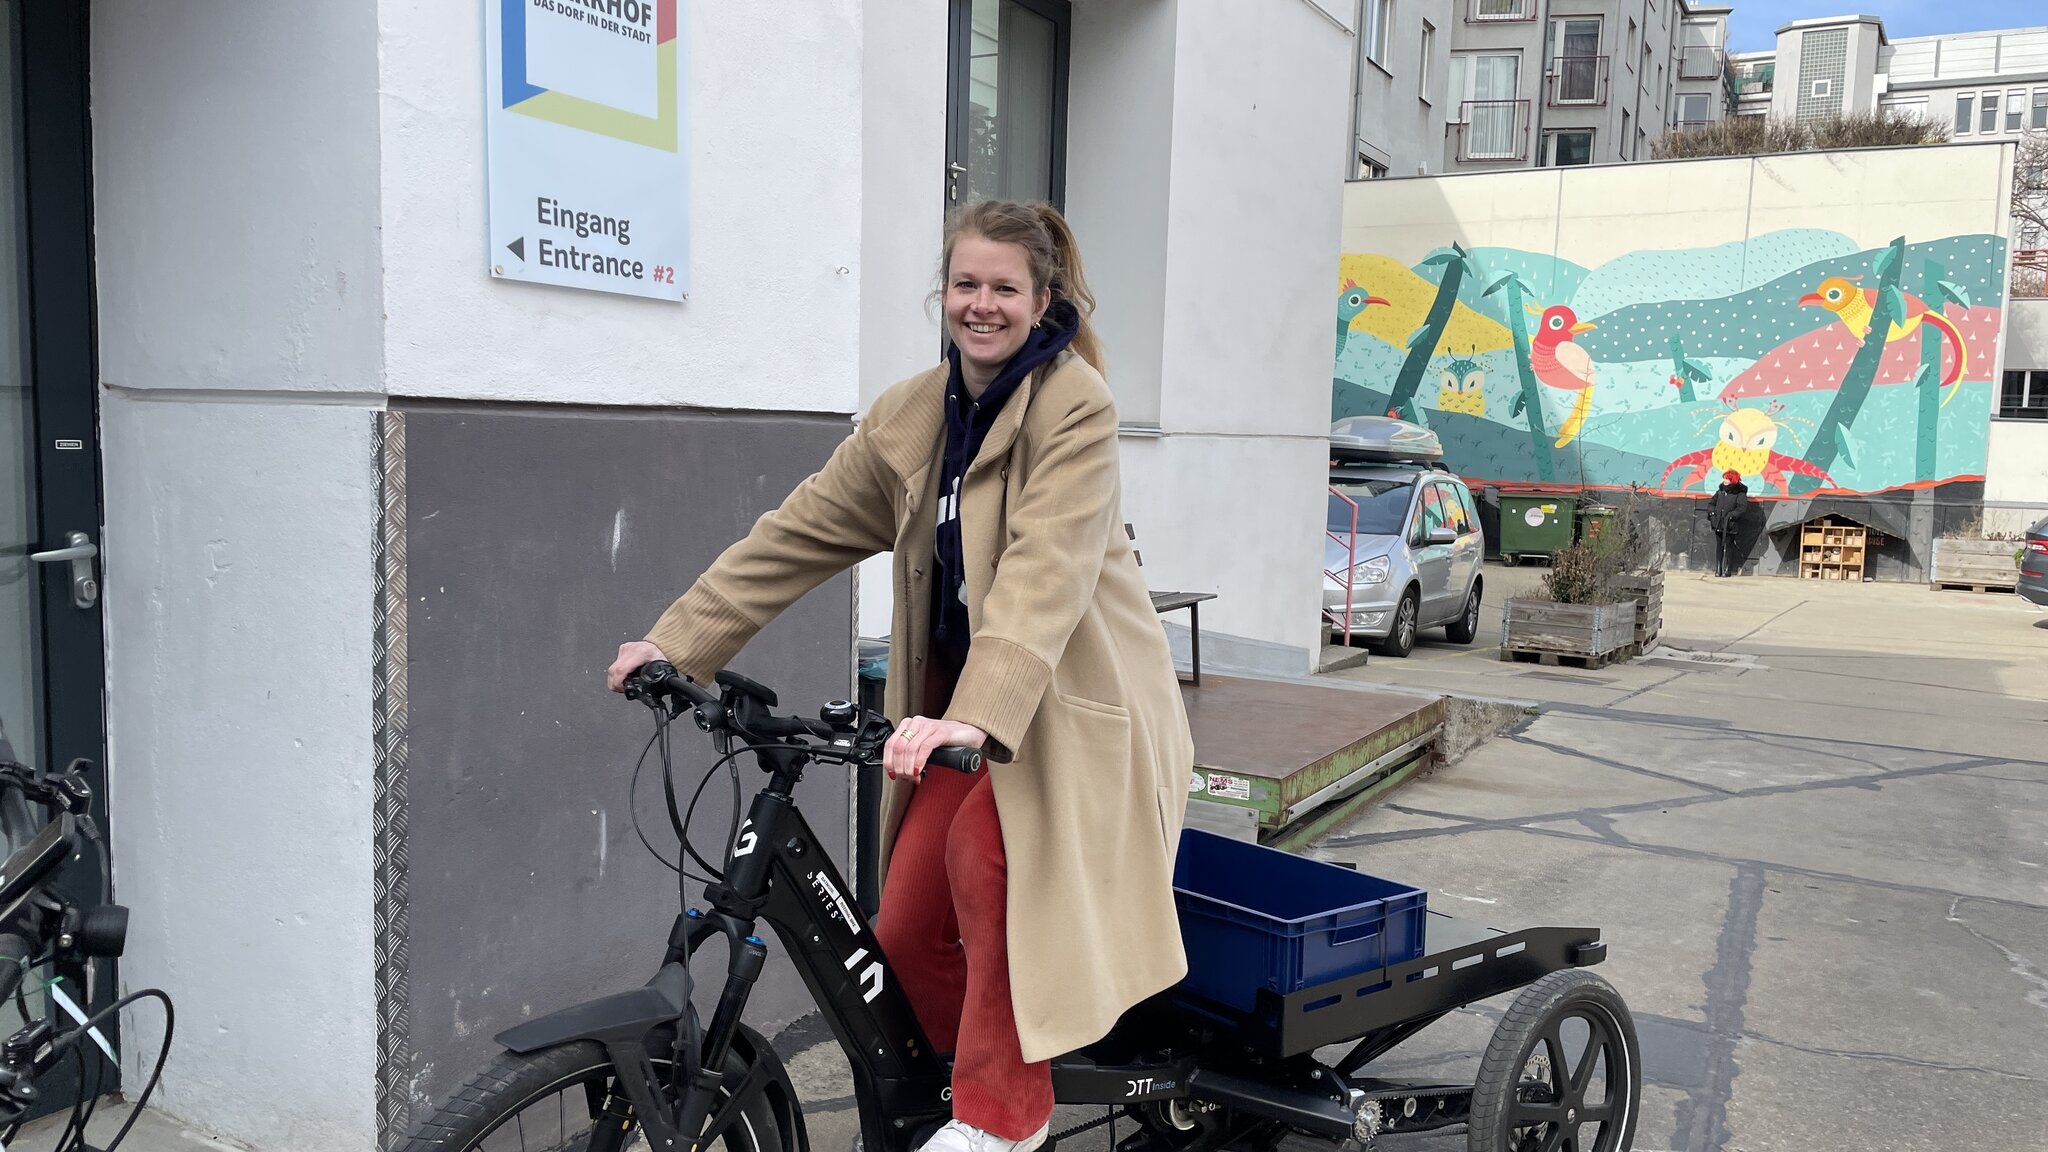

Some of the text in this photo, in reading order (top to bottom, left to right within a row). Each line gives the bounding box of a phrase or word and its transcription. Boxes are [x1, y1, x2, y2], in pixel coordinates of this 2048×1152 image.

[557, 3, 585, 21] DORF
[587, 13, 599, 27] IN
[601, 19, 620, 34] DER
[621, 25, 652, 44] STADT
[537, 196, 631, 245] Eingang
[538, 238, 675, 284] Entrance #2
[1125, 1077, 1153, 1097] DTT
